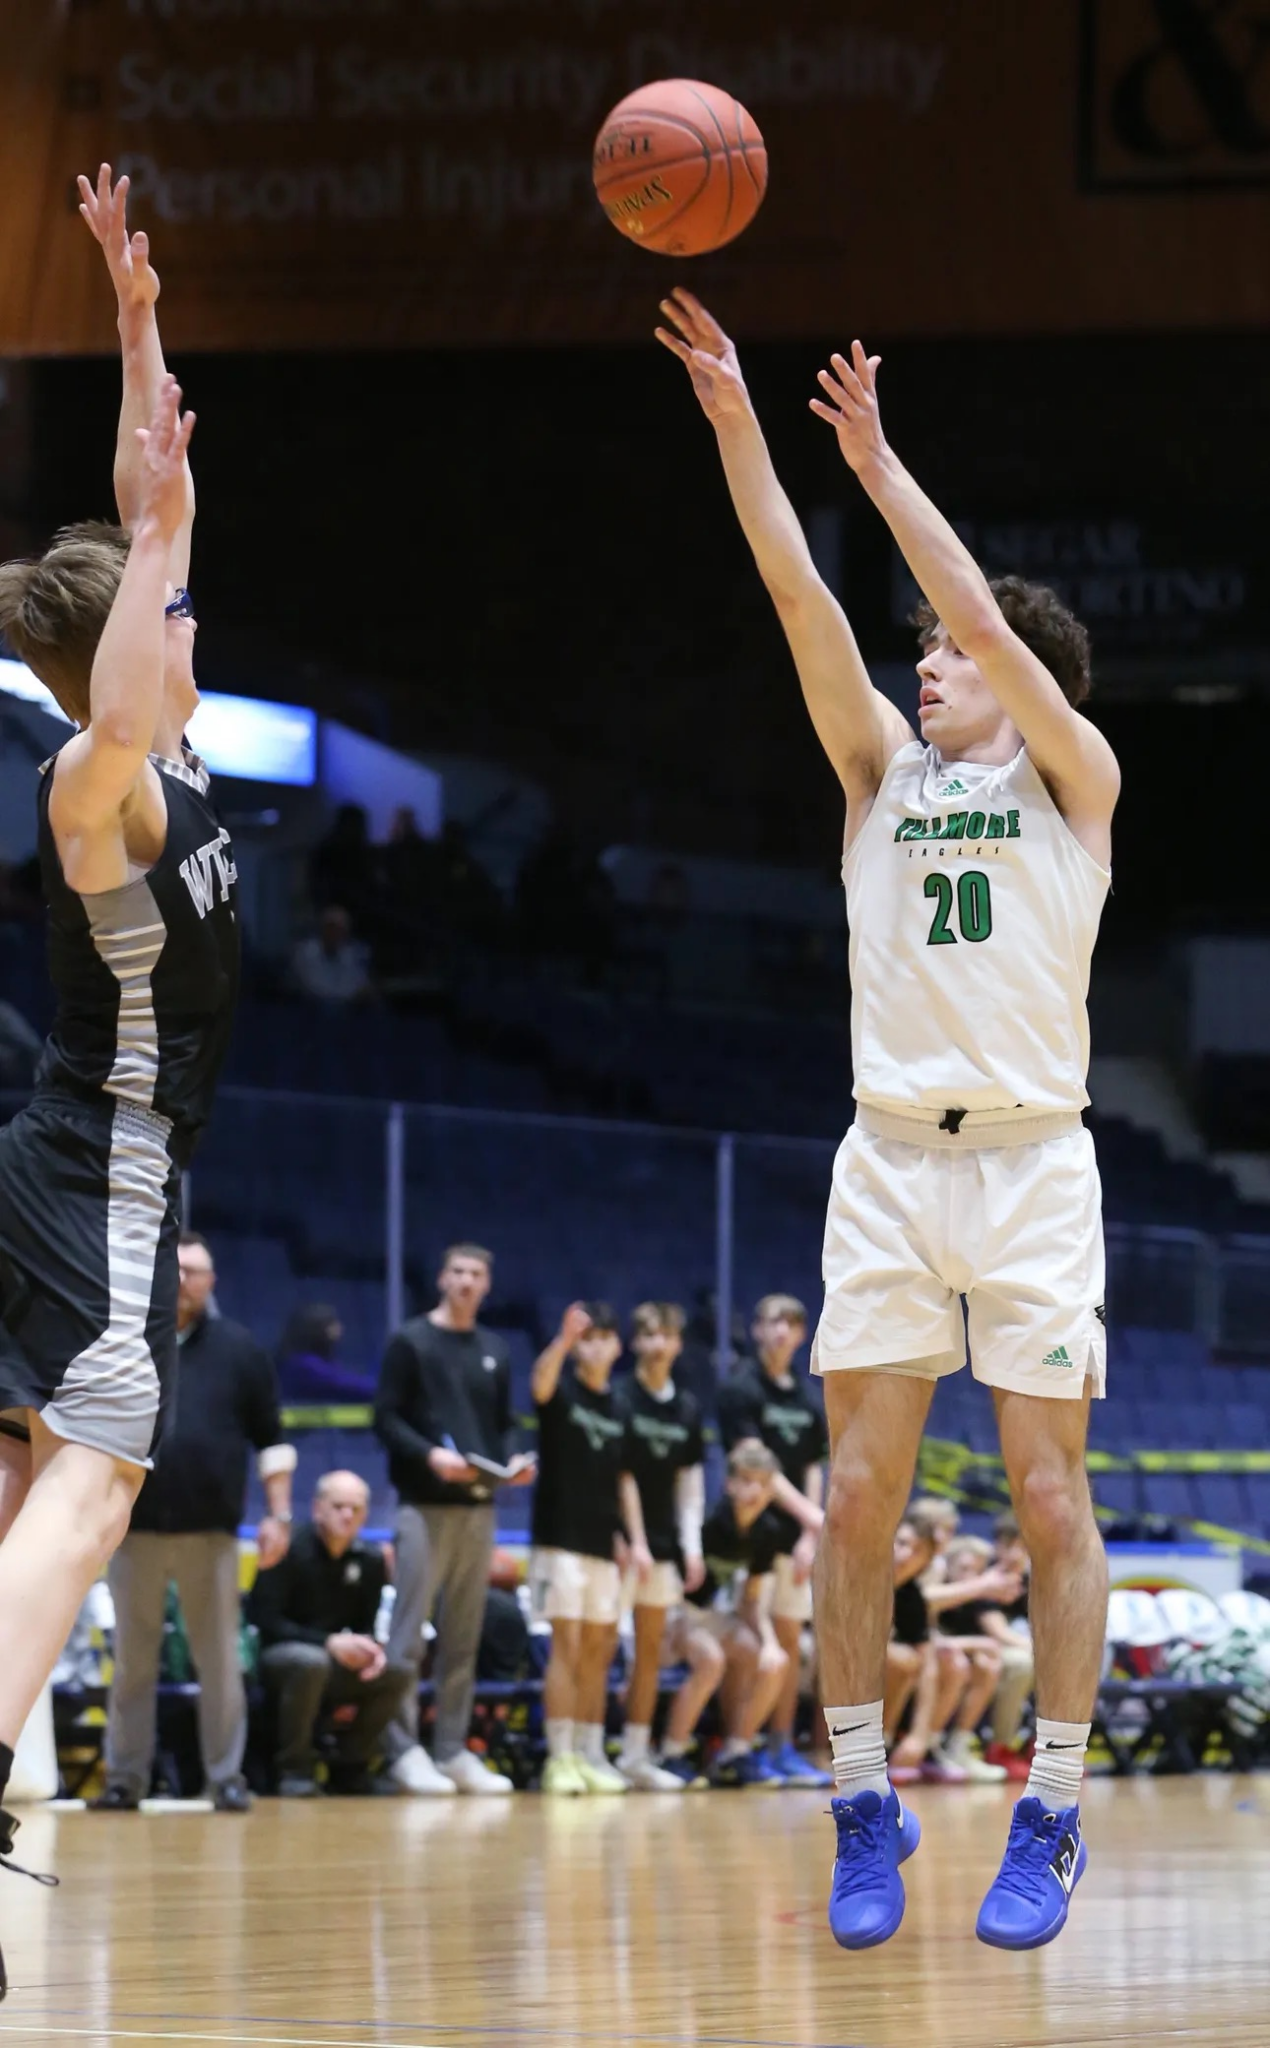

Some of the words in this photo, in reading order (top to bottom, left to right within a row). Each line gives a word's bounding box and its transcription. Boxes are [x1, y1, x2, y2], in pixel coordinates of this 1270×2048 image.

[117, 45, 315, 121] Social
[331, 40, 610, 130] Security
[117, 144, 402, 222] Personal
[422, 142, 598, 230] Injur
[894, 809, 1021, 843] FILLMORE
[908, 846, 1000, 858] EAGLES
[923, 870, 993, 945] 20
[1042, 1357, 1073, 1368] adidas
